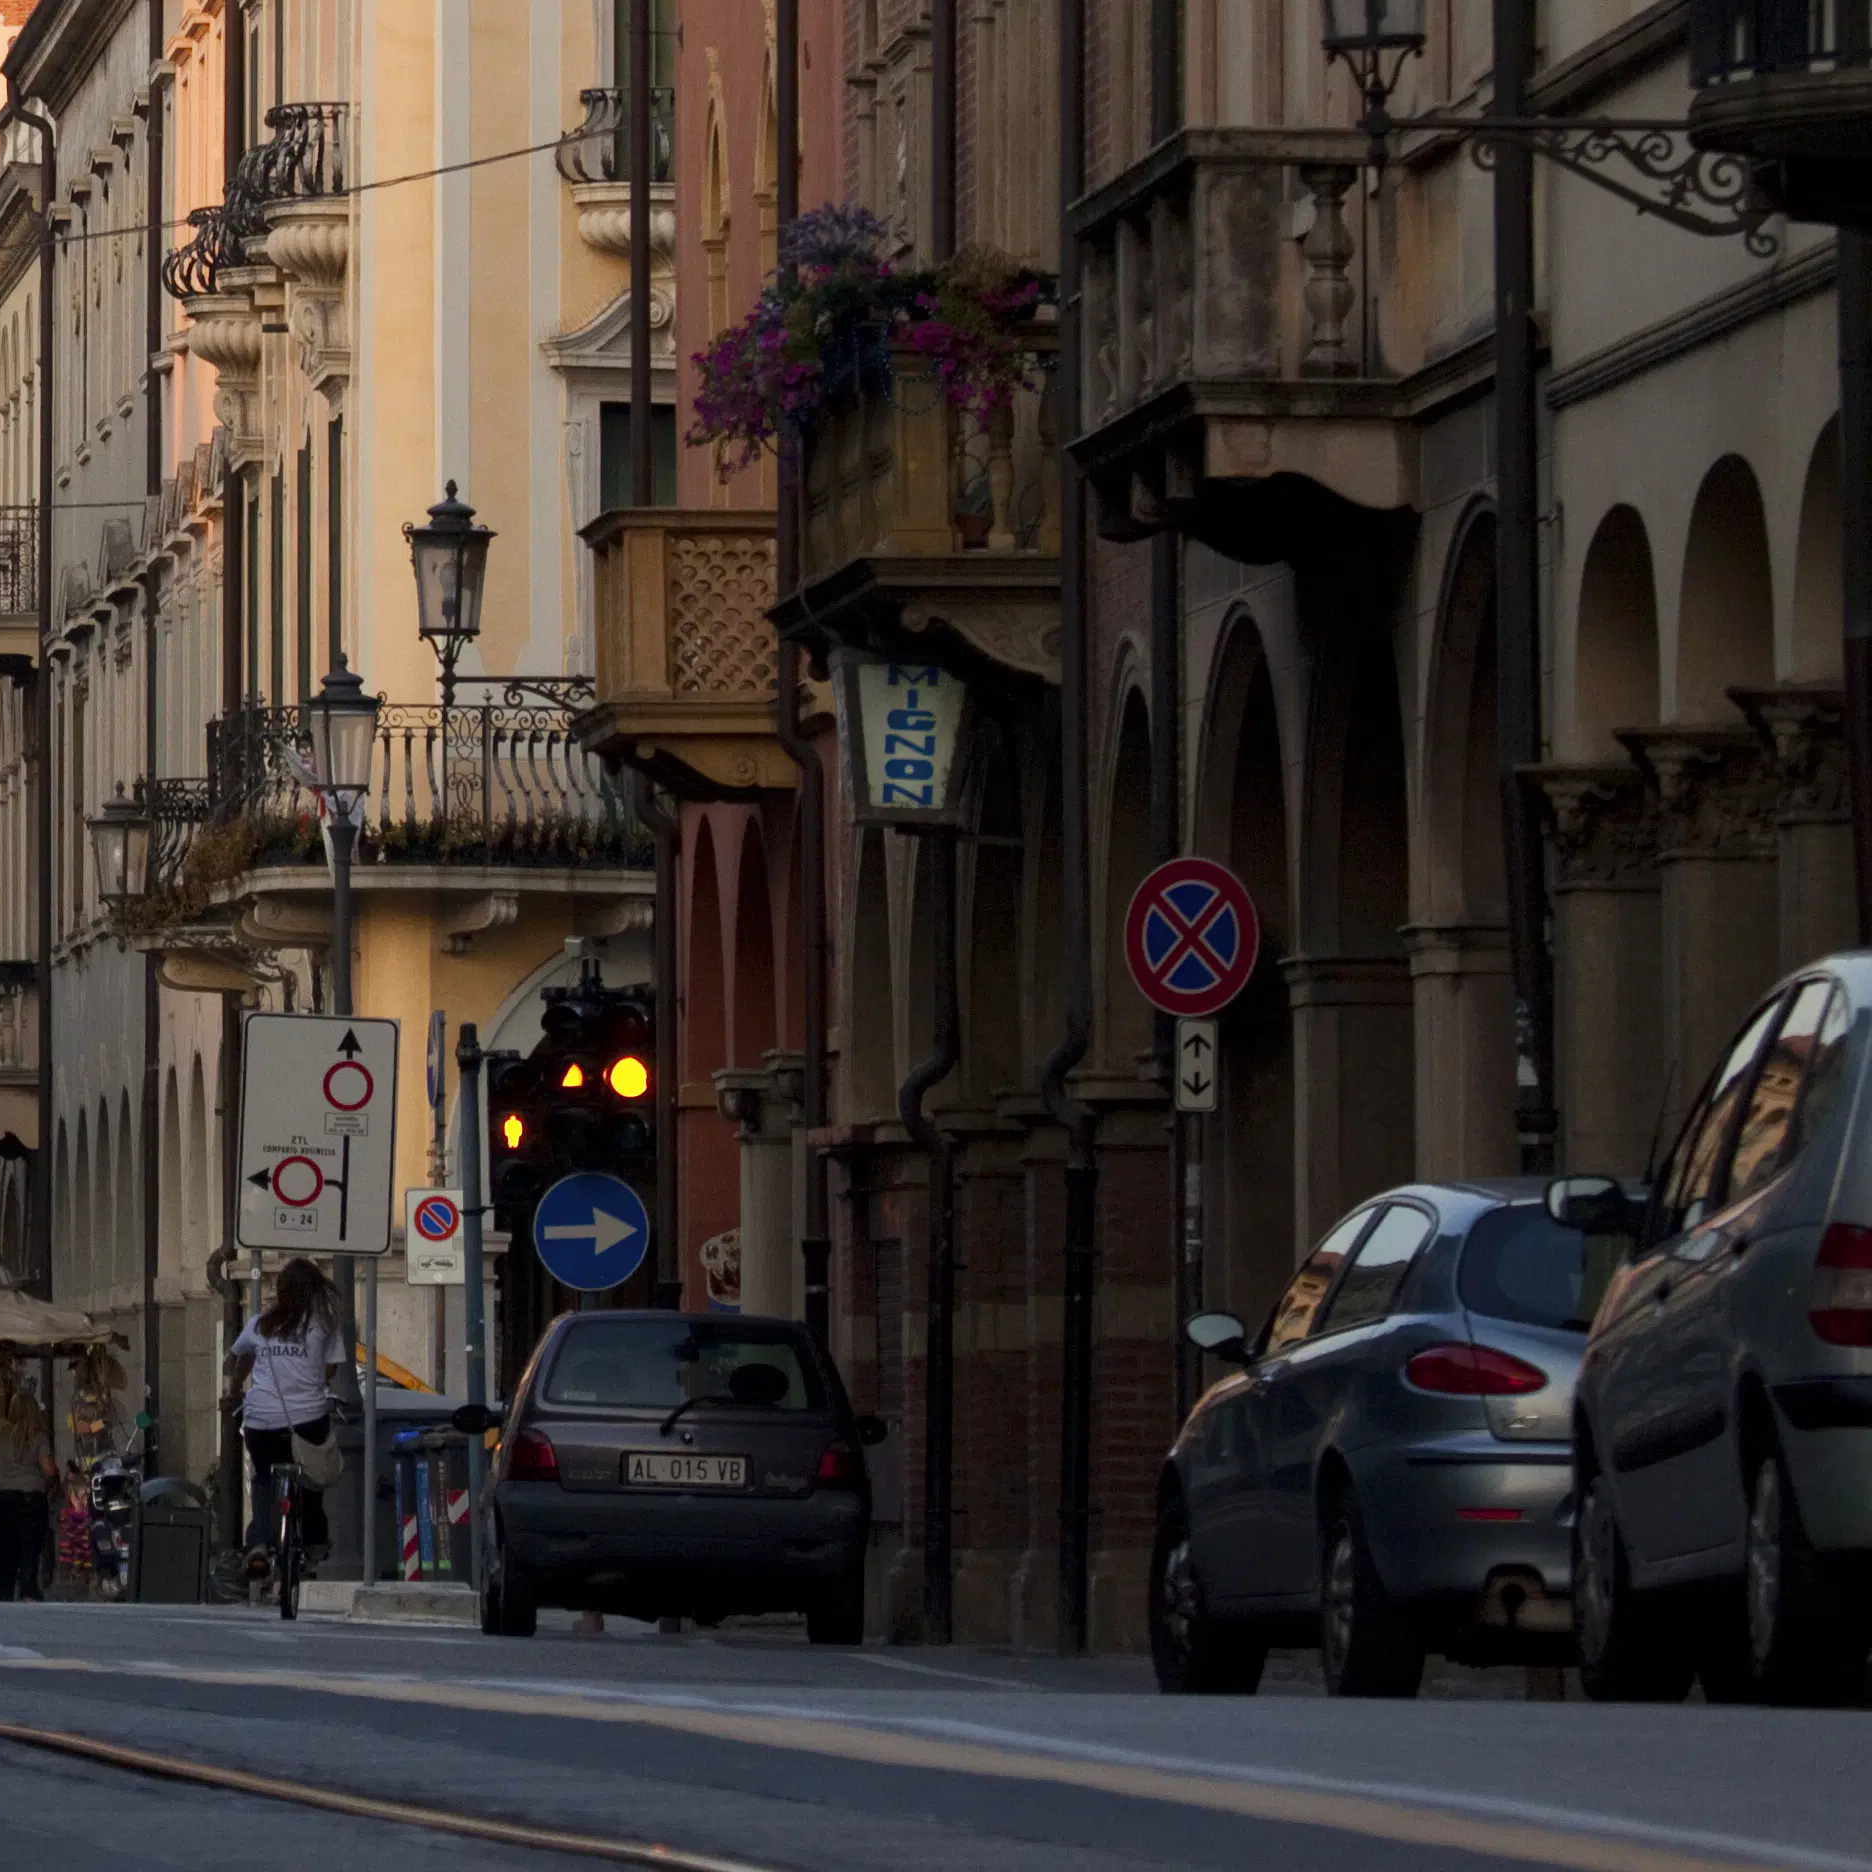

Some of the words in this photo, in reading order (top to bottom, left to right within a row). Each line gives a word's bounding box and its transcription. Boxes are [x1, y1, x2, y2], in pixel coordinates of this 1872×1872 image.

[882, 660, 940, 806] MIGNON
[290, 1135, 309, 1145] ZTL
[300, 1214, 313, 1225] 24
[261, 1346, 309, 1358] CHIARA
[633, 1459, 657, 1480] AL
[670, 1460, 708, 1481] 015
[718, 1460, 742, 1482] VB
